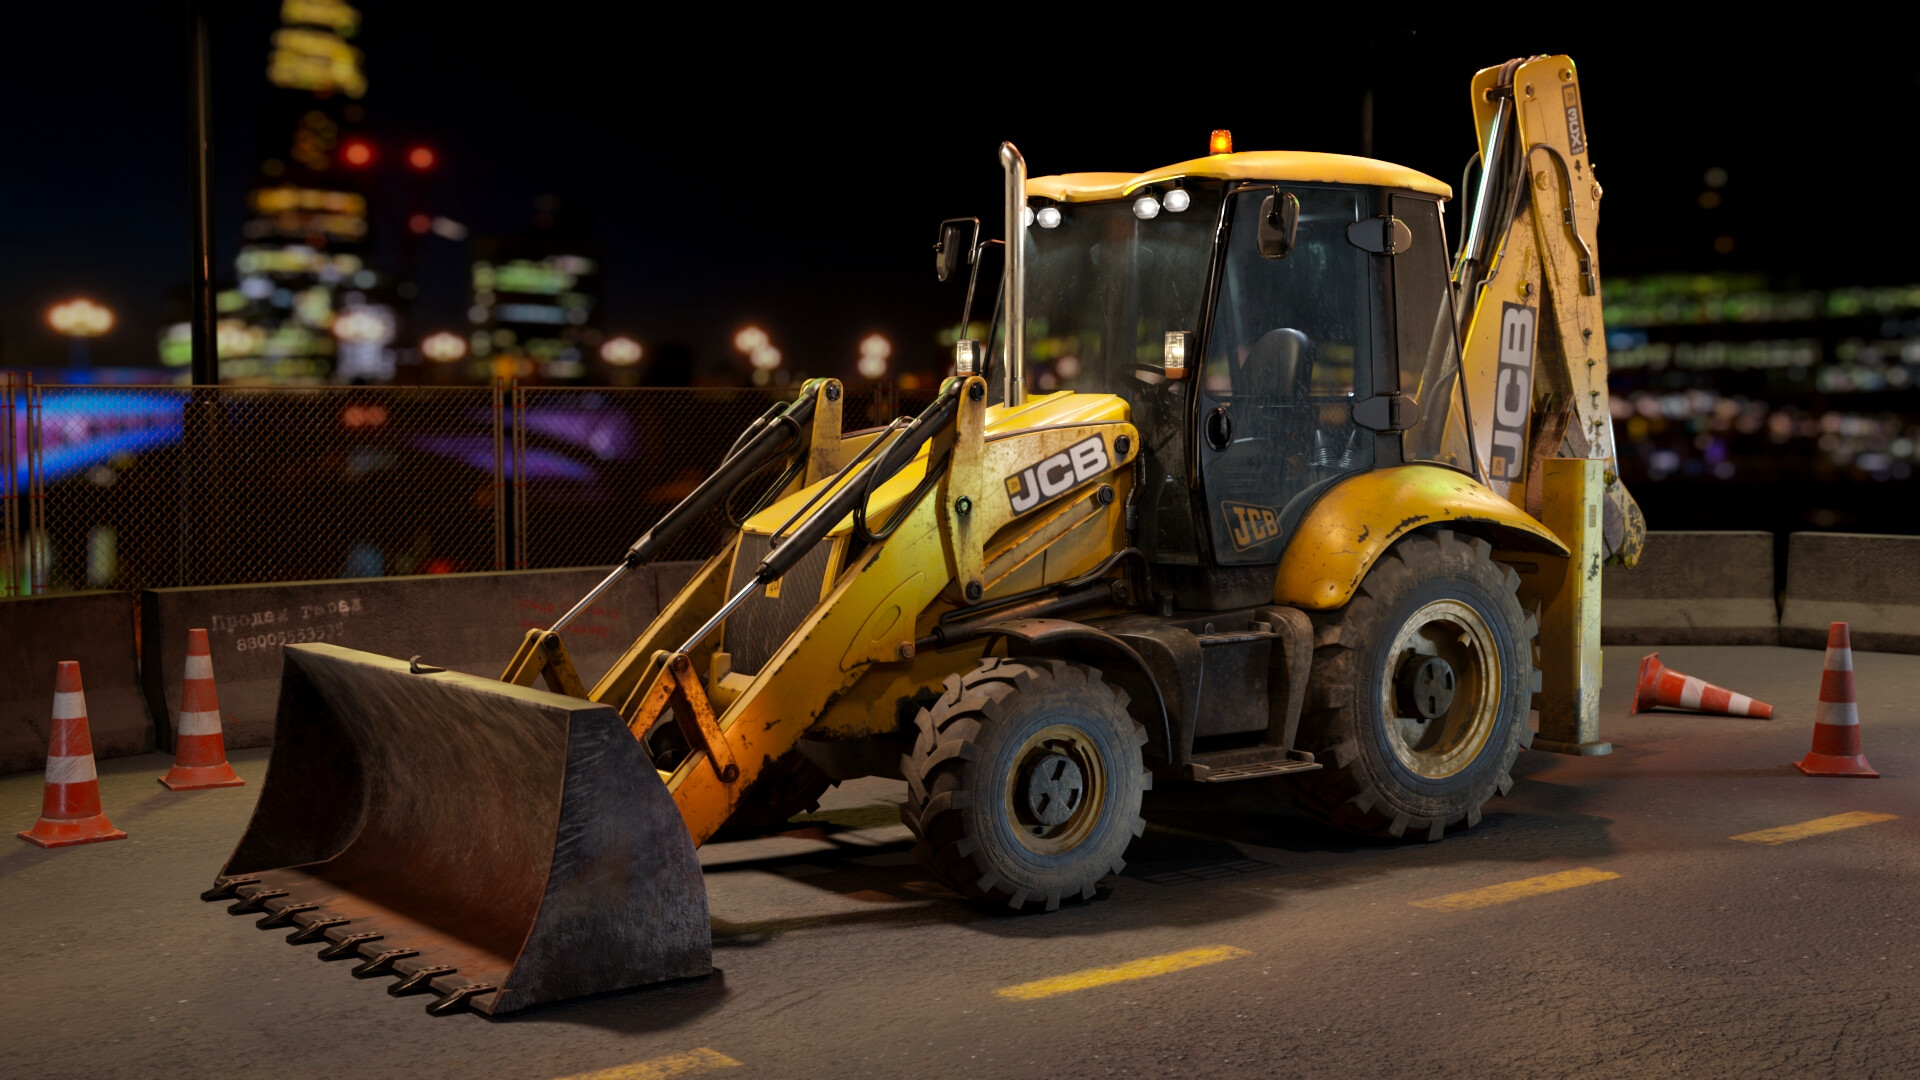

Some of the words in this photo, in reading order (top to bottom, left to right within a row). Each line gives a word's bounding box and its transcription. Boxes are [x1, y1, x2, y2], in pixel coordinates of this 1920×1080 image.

[1494, 308, 1533, 478] JCB
[1011, 436, 1108, 512] JCB
[1232, 506, 1279, 546] JCB
